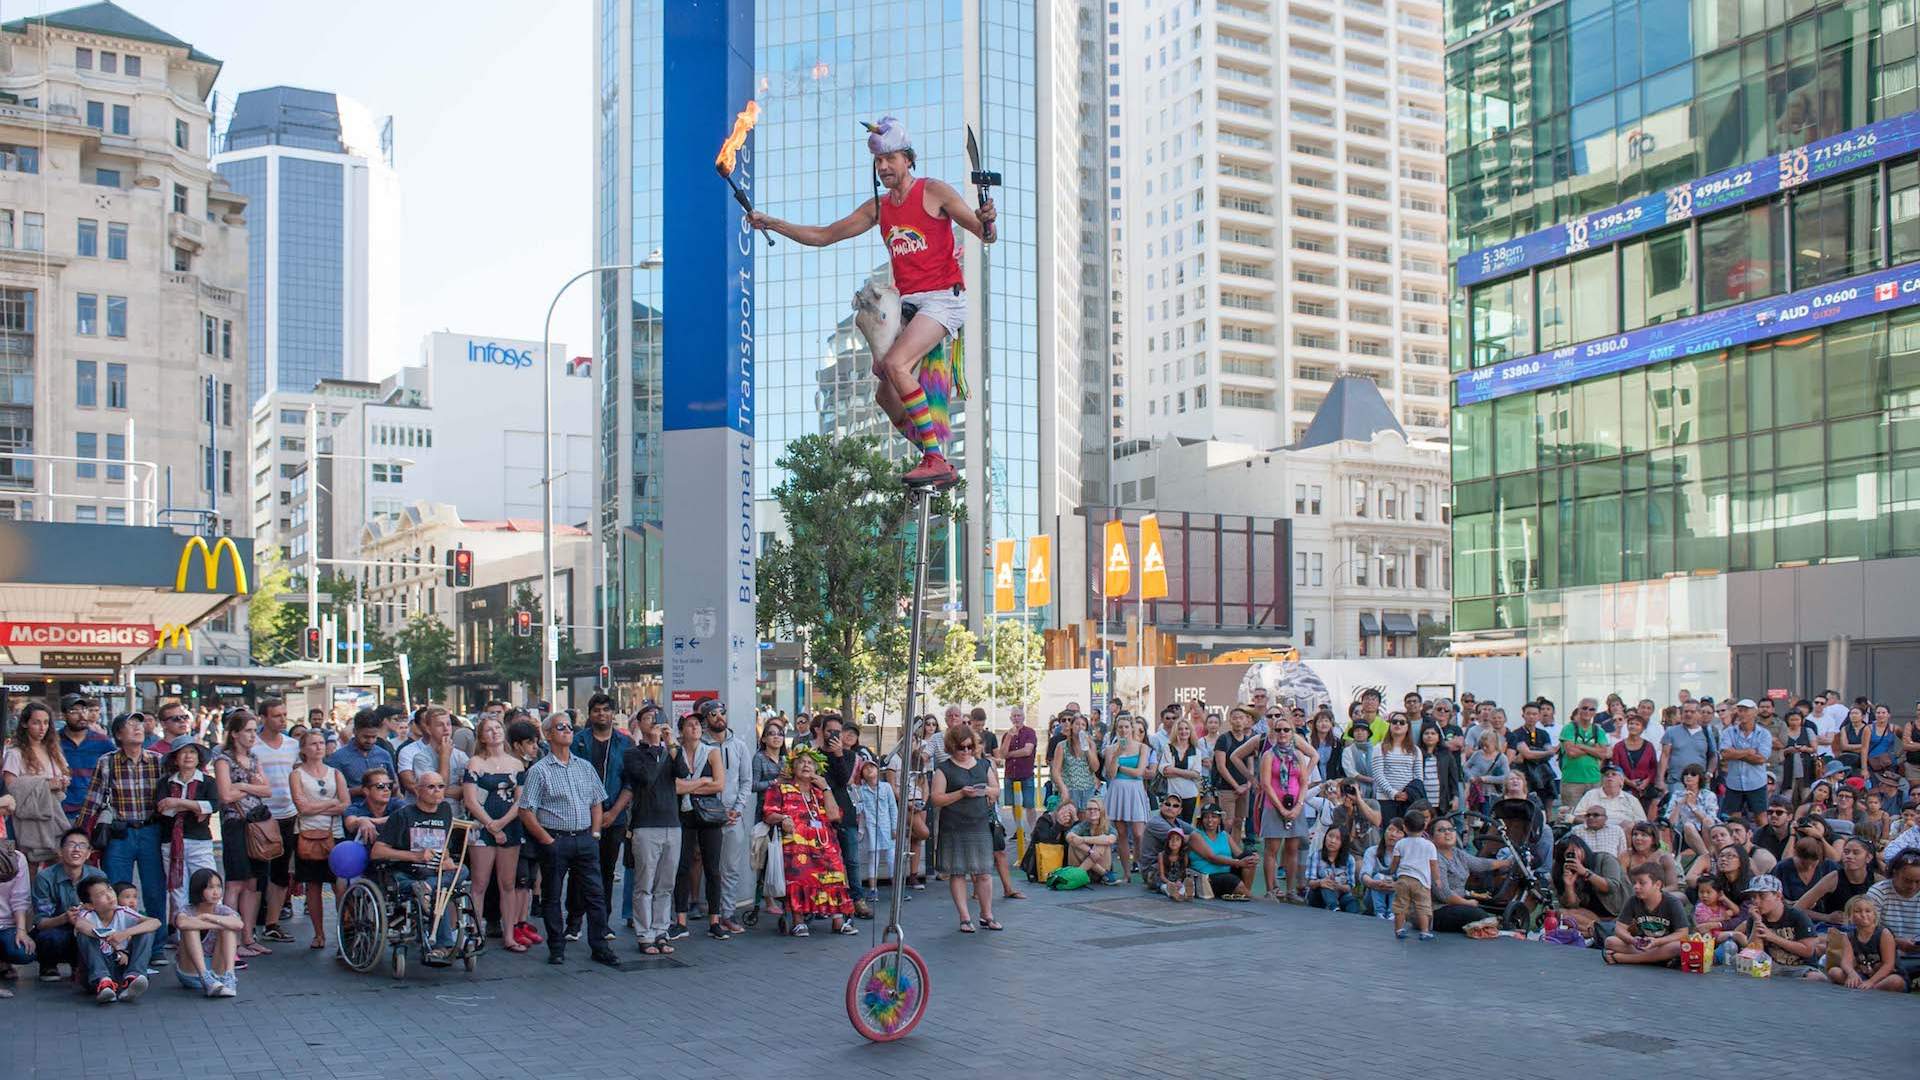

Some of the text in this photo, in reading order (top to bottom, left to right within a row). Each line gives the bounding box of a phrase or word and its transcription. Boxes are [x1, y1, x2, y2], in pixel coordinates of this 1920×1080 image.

[1814, 132, 1877, 160] 7134.26
[1779, 151, 1808, 180] 50
[1695, 171, 1752, 198] 4984.22
[739, 144, 751, 256] Cetre
[1666, 190, 1692, 212] 20
[1593, 206, 1642, 231] 1395.25
[1567, 227, 1589, 246] 10
[893, 238, 928, 257] MAGICAL
[1483, 245, 1523, 265] 5:38pm
[1813, 288, 1857, 308] 0.9600
[1779, 306, 1809, 321] AUD
[468, 340, 533, 370] Infosys
[738, 267, 754, 430] Transport
[1553, 347, 1577, 360] AMF
[1586, 338, 1628, 357] 5380.0
[1648, 346, 1676, 361] AMF
[1472, 361, 1540, 382] AMF 5380.0
[739, 440, 751, 604] Britomart
[9, 625, 149, 644] McDonald's
[1174, 687, 1206, 702] HERE
